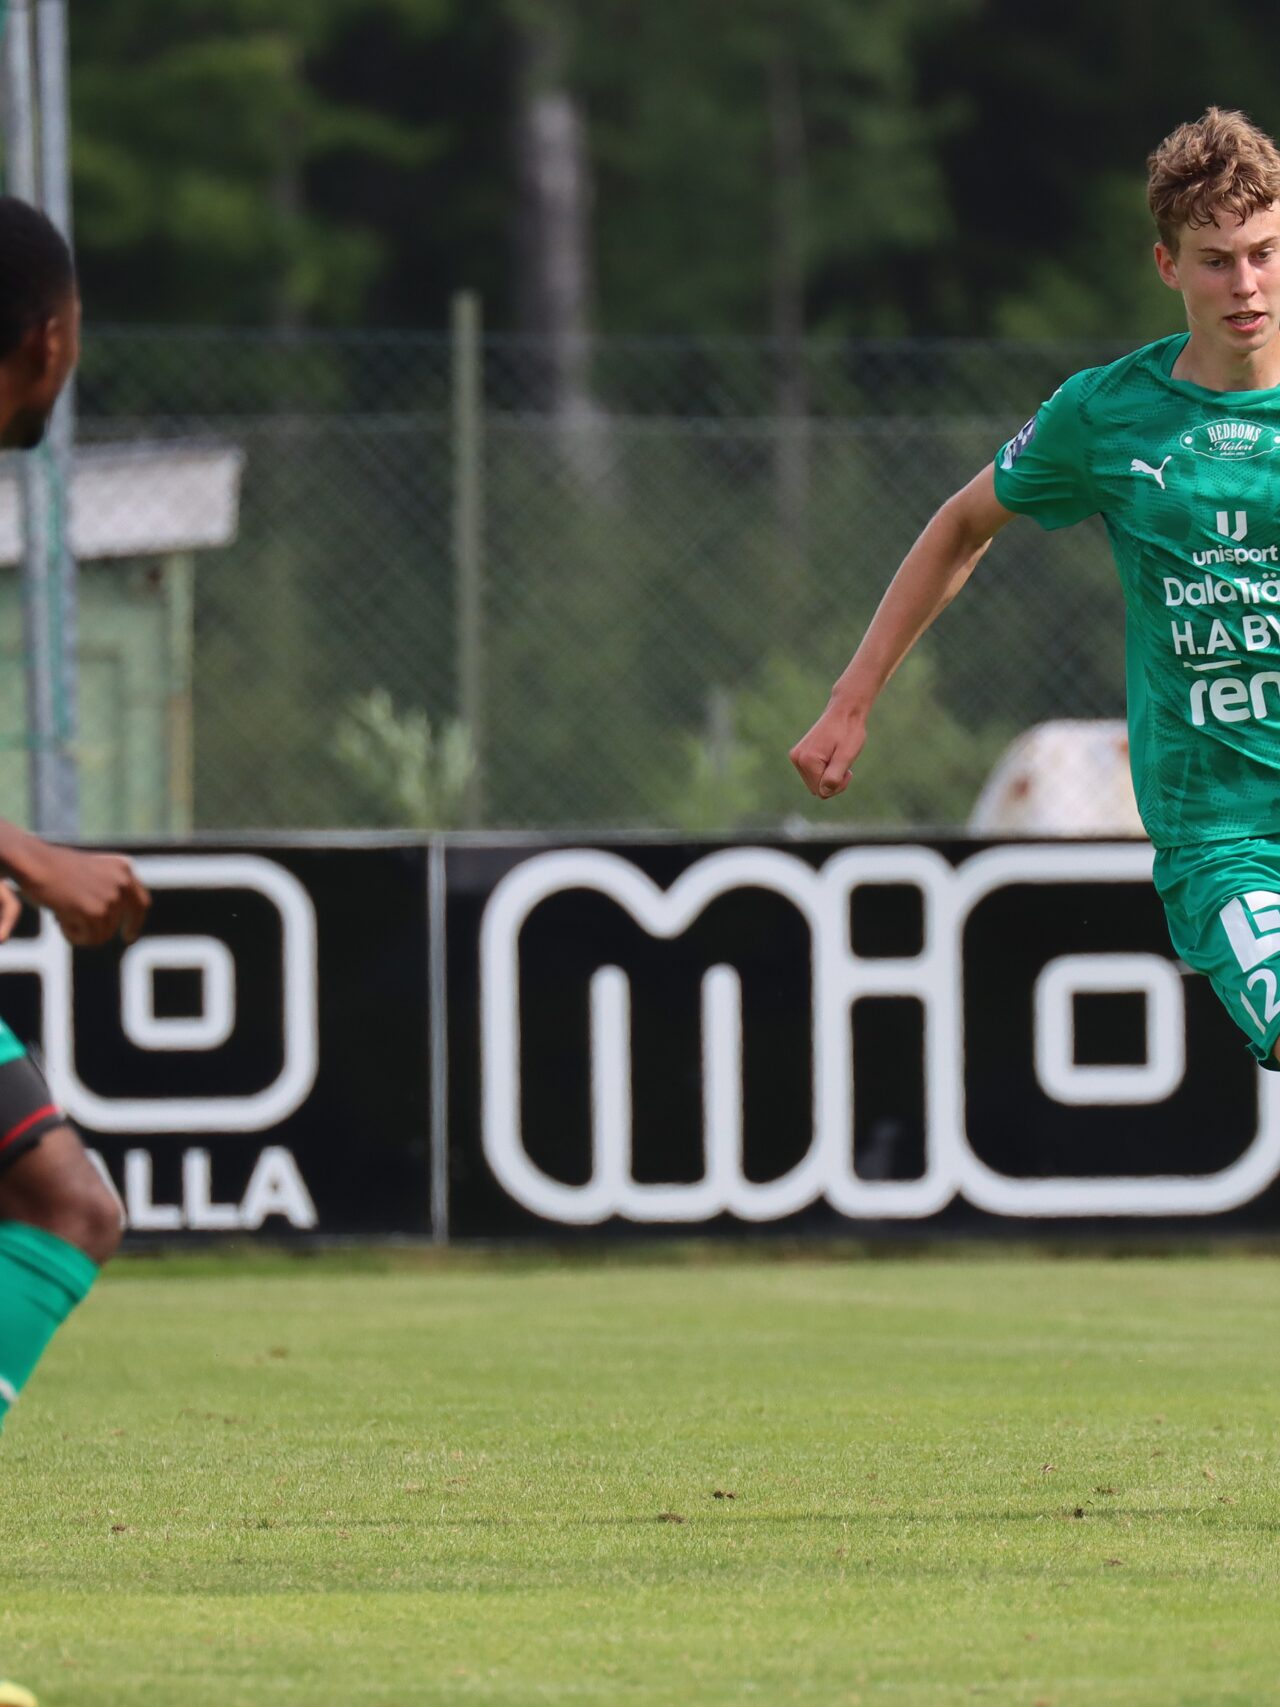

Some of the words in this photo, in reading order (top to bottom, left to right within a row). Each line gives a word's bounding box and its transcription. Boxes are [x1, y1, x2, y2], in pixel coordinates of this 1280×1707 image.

[1206, 422, 1263, 443] HEDBOMS
[1192, 543, 1279, 567] unisport
[1169, 616, 1237, 656] H.A
